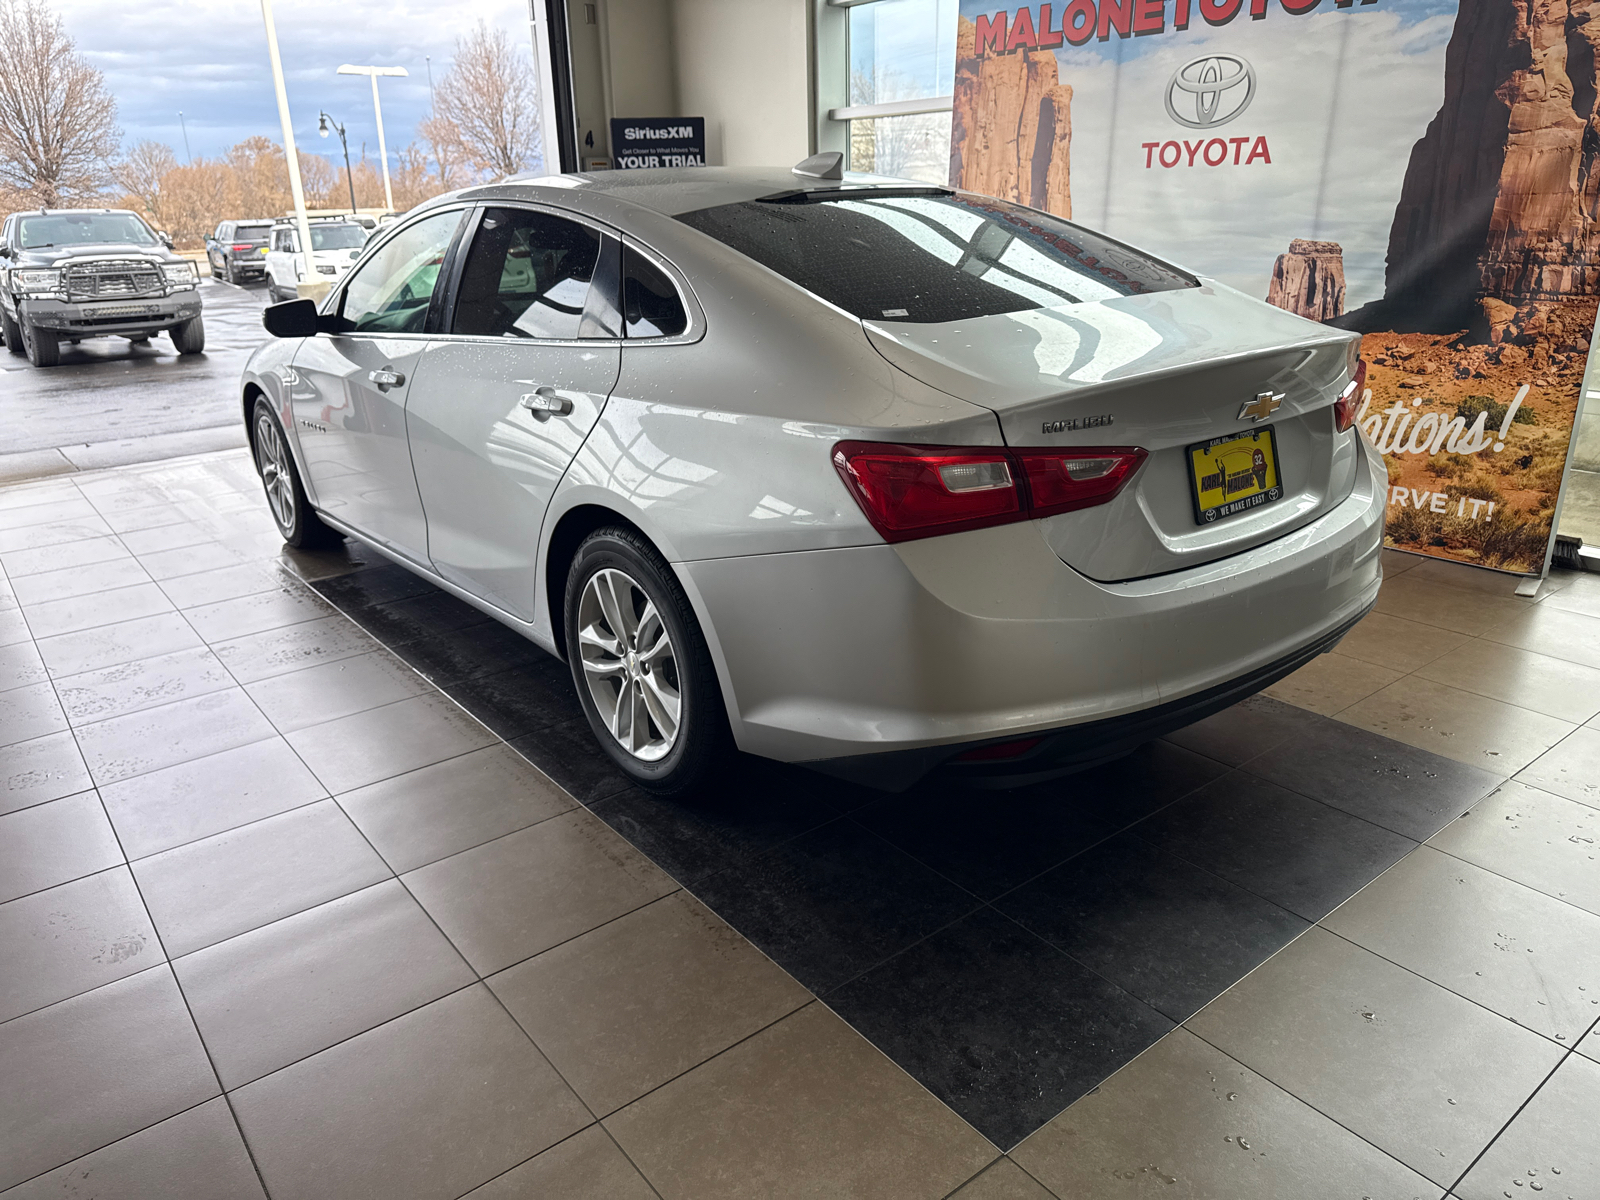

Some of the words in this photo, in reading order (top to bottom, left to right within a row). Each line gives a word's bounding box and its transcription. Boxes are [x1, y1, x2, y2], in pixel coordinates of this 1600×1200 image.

[585, 130, 594, 149] 4
[624, 126, 693, 140] SiriusXM
[618, 155, 660, 169] YOUR
[661, 154, 705, 168] TRIAL
[1141, 136, 1272, 169] TOYOTA
[1042, 413, 1114, 434] MALIBU
[1254, 454, 1263, 466] 32
[1201, 472, 1222, 493] KARL
[1227, 472, 1255, 495] MALONE
[1220, 505, 1229, 516] WE
[1230, 500, 1245, 513] MAKE
[1245, 497, 1251, 508] IT
[1252, 493, 1265, 506] EASY
[1387, 484, 1449, 514] RVE
[1457, 496, 1496, 522] IT!
